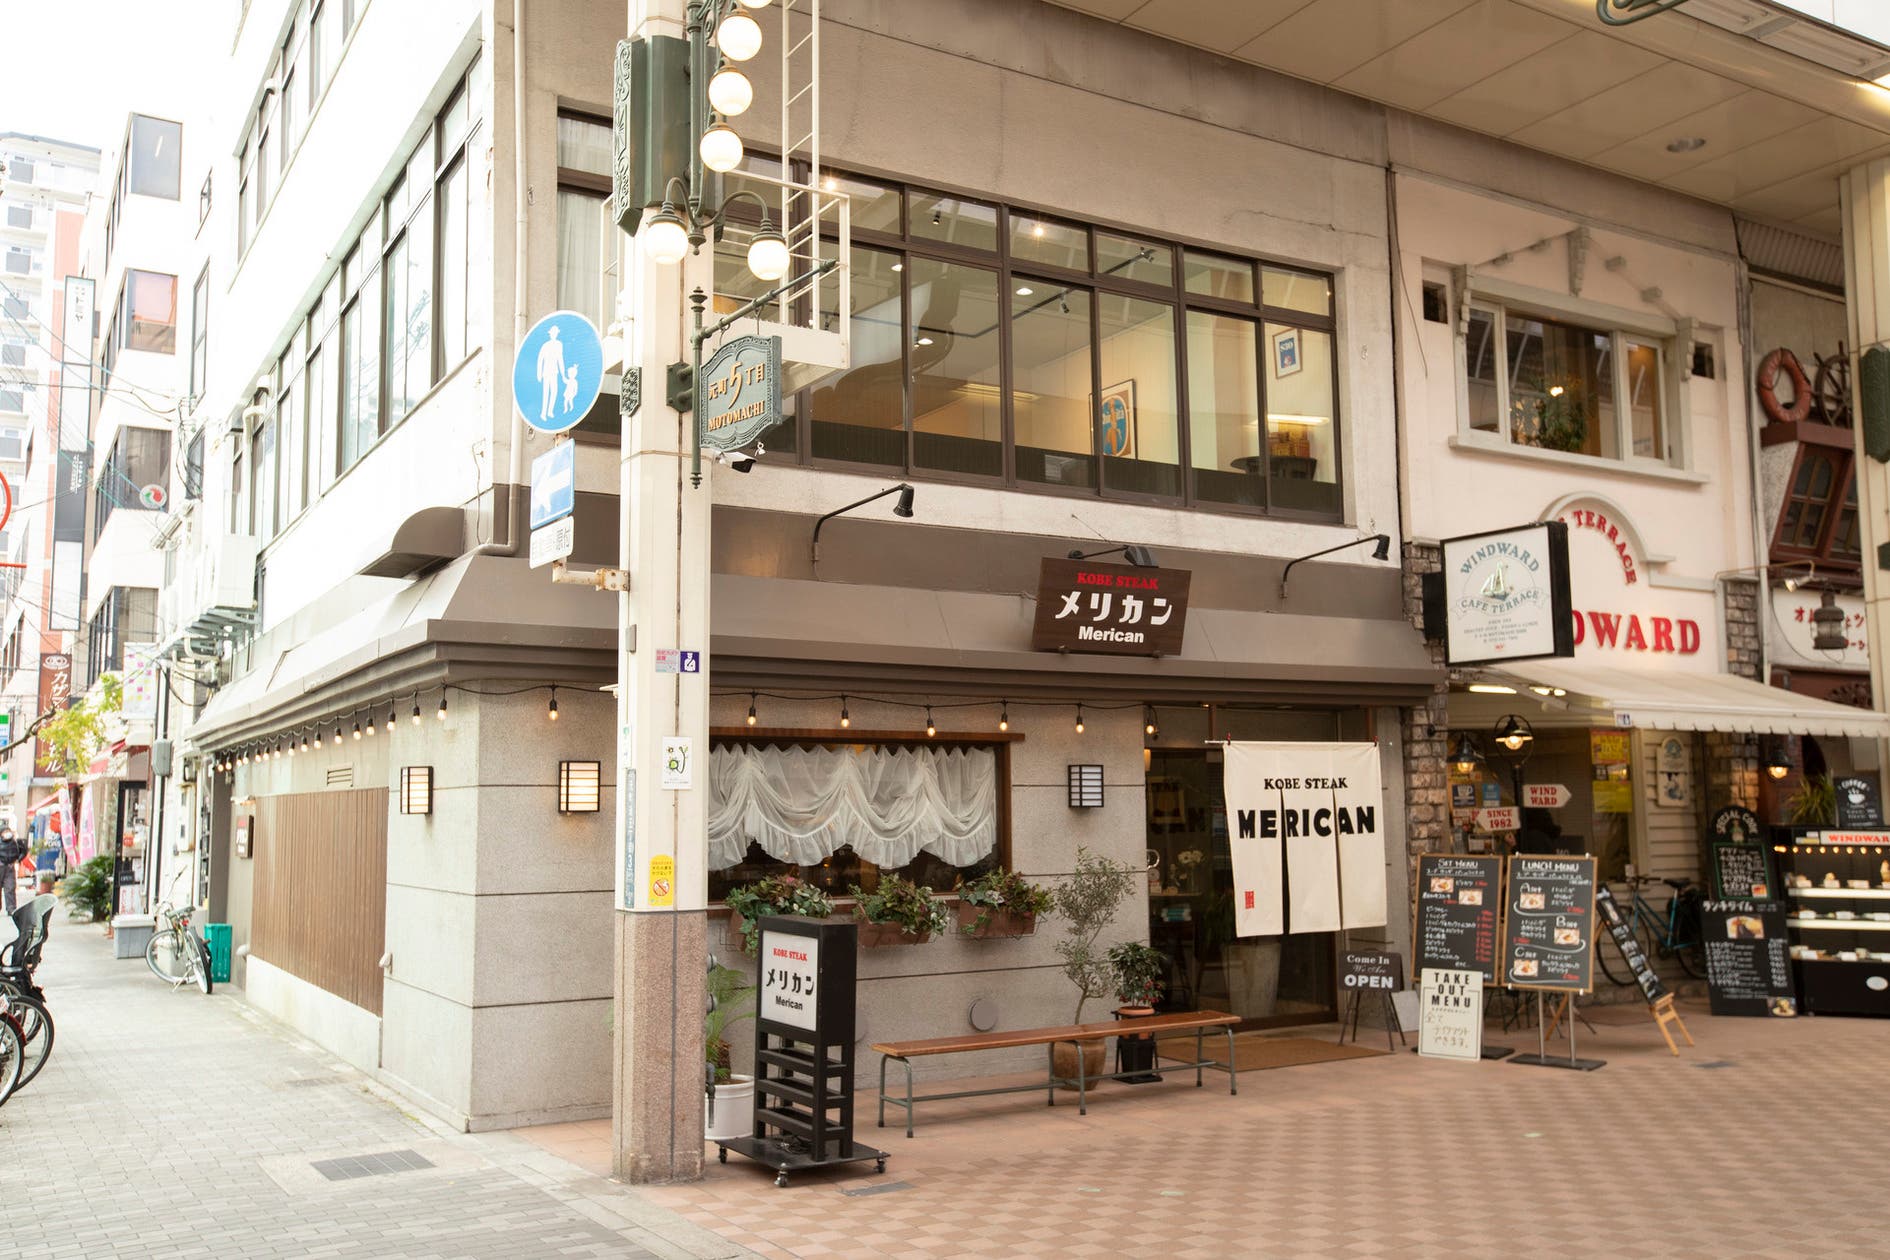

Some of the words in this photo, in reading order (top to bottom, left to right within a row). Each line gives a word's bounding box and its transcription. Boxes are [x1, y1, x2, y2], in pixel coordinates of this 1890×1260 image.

[709, 361, 765, 410] 元町5丁目
[709, 401, 765, 432] MOTOMACHI
[1573, 509, 1638, 585] TERRACE
[1460, 542, 1540, 574] WINDWARD
[1077, 572, 1113, 586] KOBE
[1116, 575, 1159, 590] STEAK
[1055, 591, 1173, 626] メリカン
[1461, 599, 1488, 613] CAFE
[1492, 588, 1540, 614] TERRACE
[1078, 626, 1144, 643] Merican
[1264, 778, 1300, 790] KOBE
[1305, 777, 1348, 790] STEAK
[1530, 787, 1557, 795] WIND
[1531, 797, 1557, 805] WARD
[1487, 809, 1512, 817] SINCE
[1237, 806, 1375, 839] MERICAN
[1490, 819, 1512, 828] 1982
[773, 948, 788, 959] KOBE
[788, 950, 807, 961] STEAK
[1347, 954, 1376, 964] Come
[1379, 956, 1390, 965] In
[766, 968, 815, 996] メリカン
[1344, 974, 1393, 989] OPEN
[1434, 972, 1470, 985] TAKE
[1438, 984, 1465, 996] OUT
[775, 995, 803, 1010] Merican
[1431, 995, 1471, 1008] MENU
